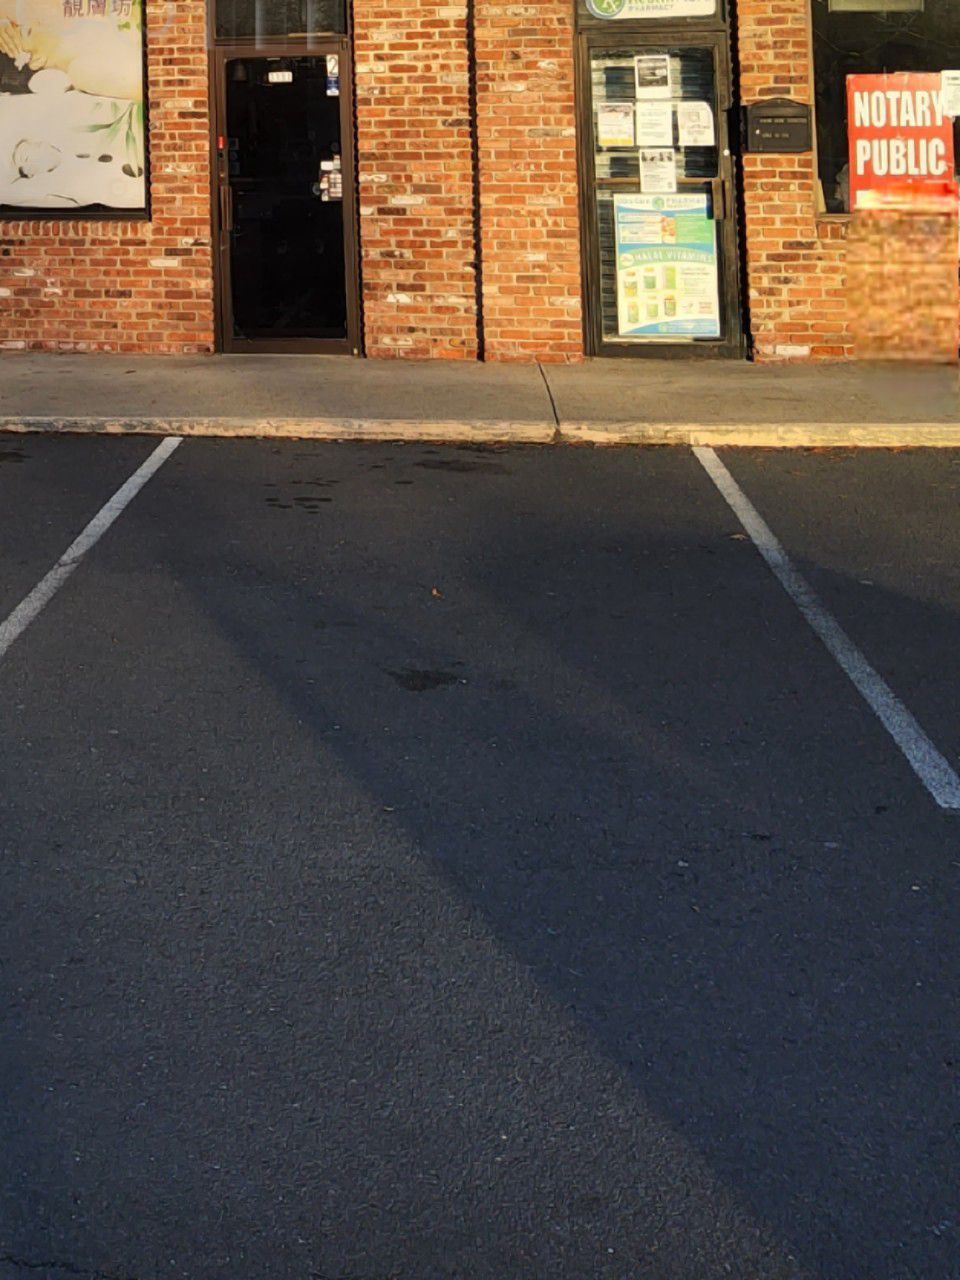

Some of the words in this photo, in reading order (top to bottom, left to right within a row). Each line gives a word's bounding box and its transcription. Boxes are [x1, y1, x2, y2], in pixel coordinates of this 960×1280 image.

[327, 56, 337, 75] 2
[854, 90, 944, 127] NOTARY
[856, 139, 948, 176] PUBLIC
